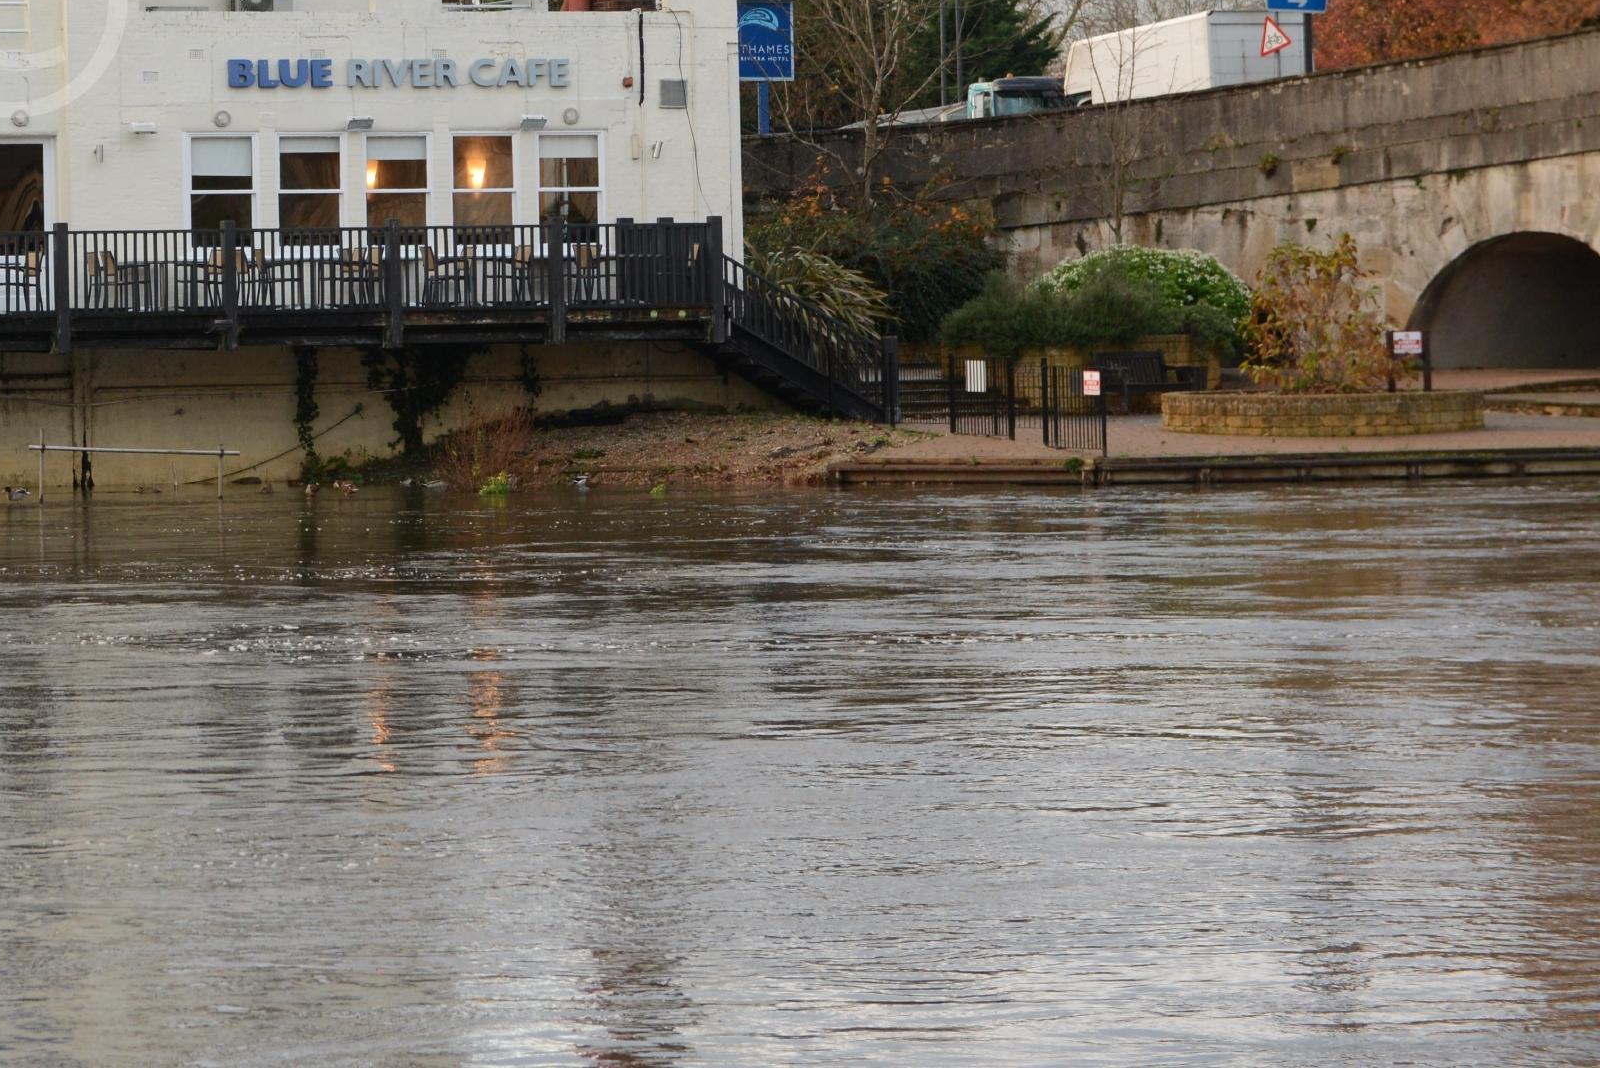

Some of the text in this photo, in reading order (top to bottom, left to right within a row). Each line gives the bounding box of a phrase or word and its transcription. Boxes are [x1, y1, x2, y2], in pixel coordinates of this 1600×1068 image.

[741, 44, 790, 54] THAMES
[227, 58, 572, 88] BLUE RIVER CAFE
